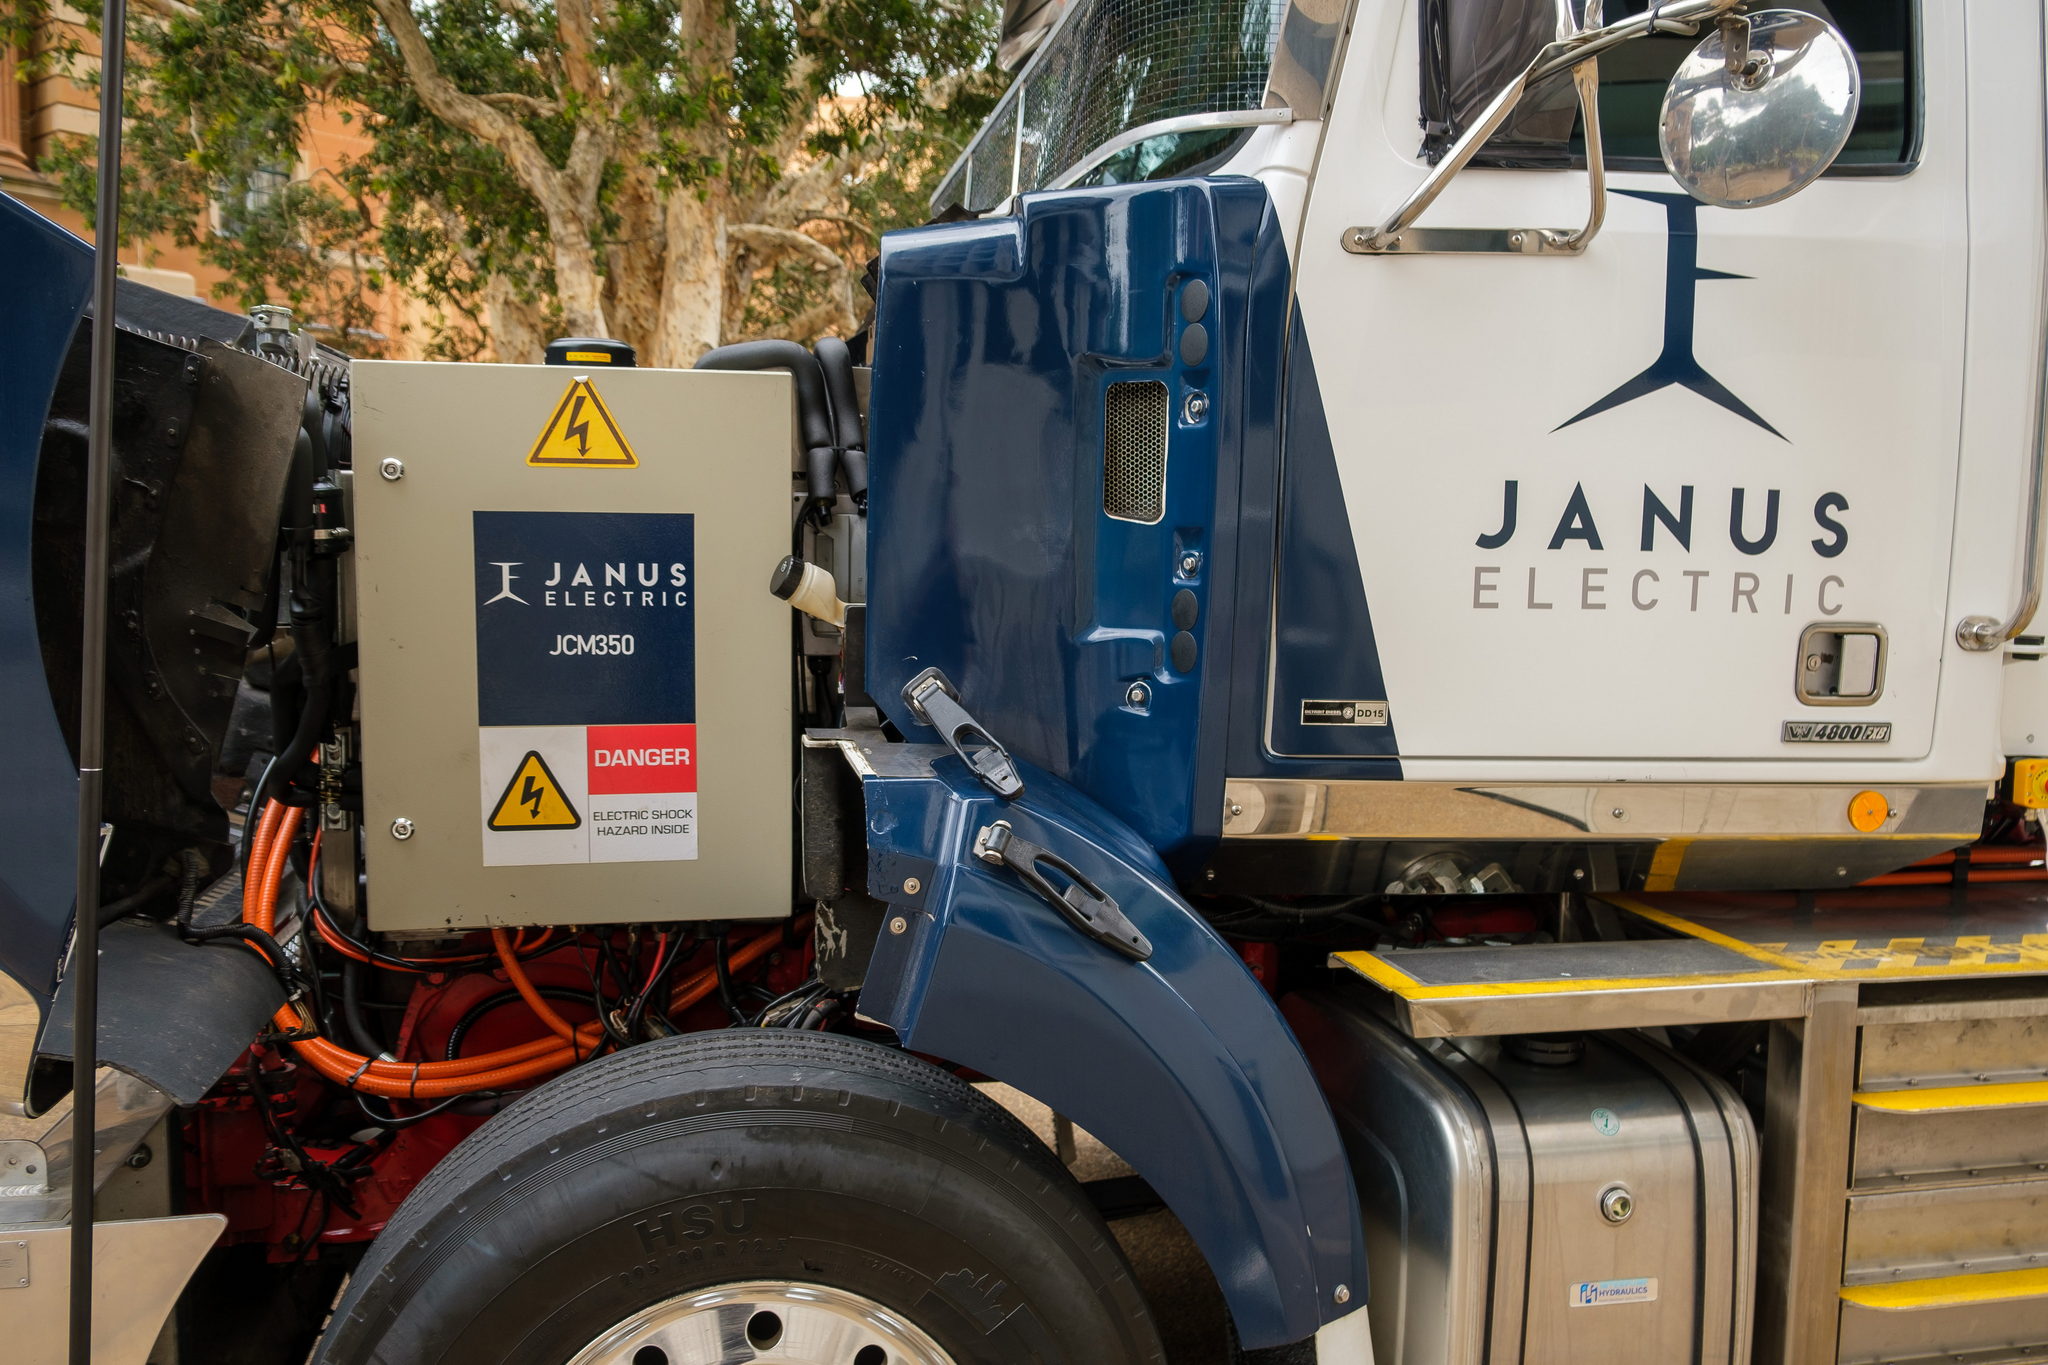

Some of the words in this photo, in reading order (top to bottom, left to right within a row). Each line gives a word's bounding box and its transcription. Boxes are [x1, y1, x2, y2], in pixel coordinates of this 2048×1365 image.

[1475, 479, 1850, 558] JANUS
[545, 562, 687, 587] JANUS
[545, 591, 687, 607] ELECTRIC
[1473, 566, 1845, 616] ELECTRIC
[549, 634, 635, 656] JCM350
[1357, 709, 1384, 718] DD15
[1815, 725, 1864, 740] 4800
[594, 748, 690, 767] DANGER
[593, 810, 649, 822] ELECTRIC
[651, 809, 693, 820] SHOCK
[597, 826, 648, 837] HAZARD
[651, 824, 690, 835] INSIDE
[633, 1197, 757, 1257] HSU
[1599, 1286, 1649, 1298] HYDRAULICS
